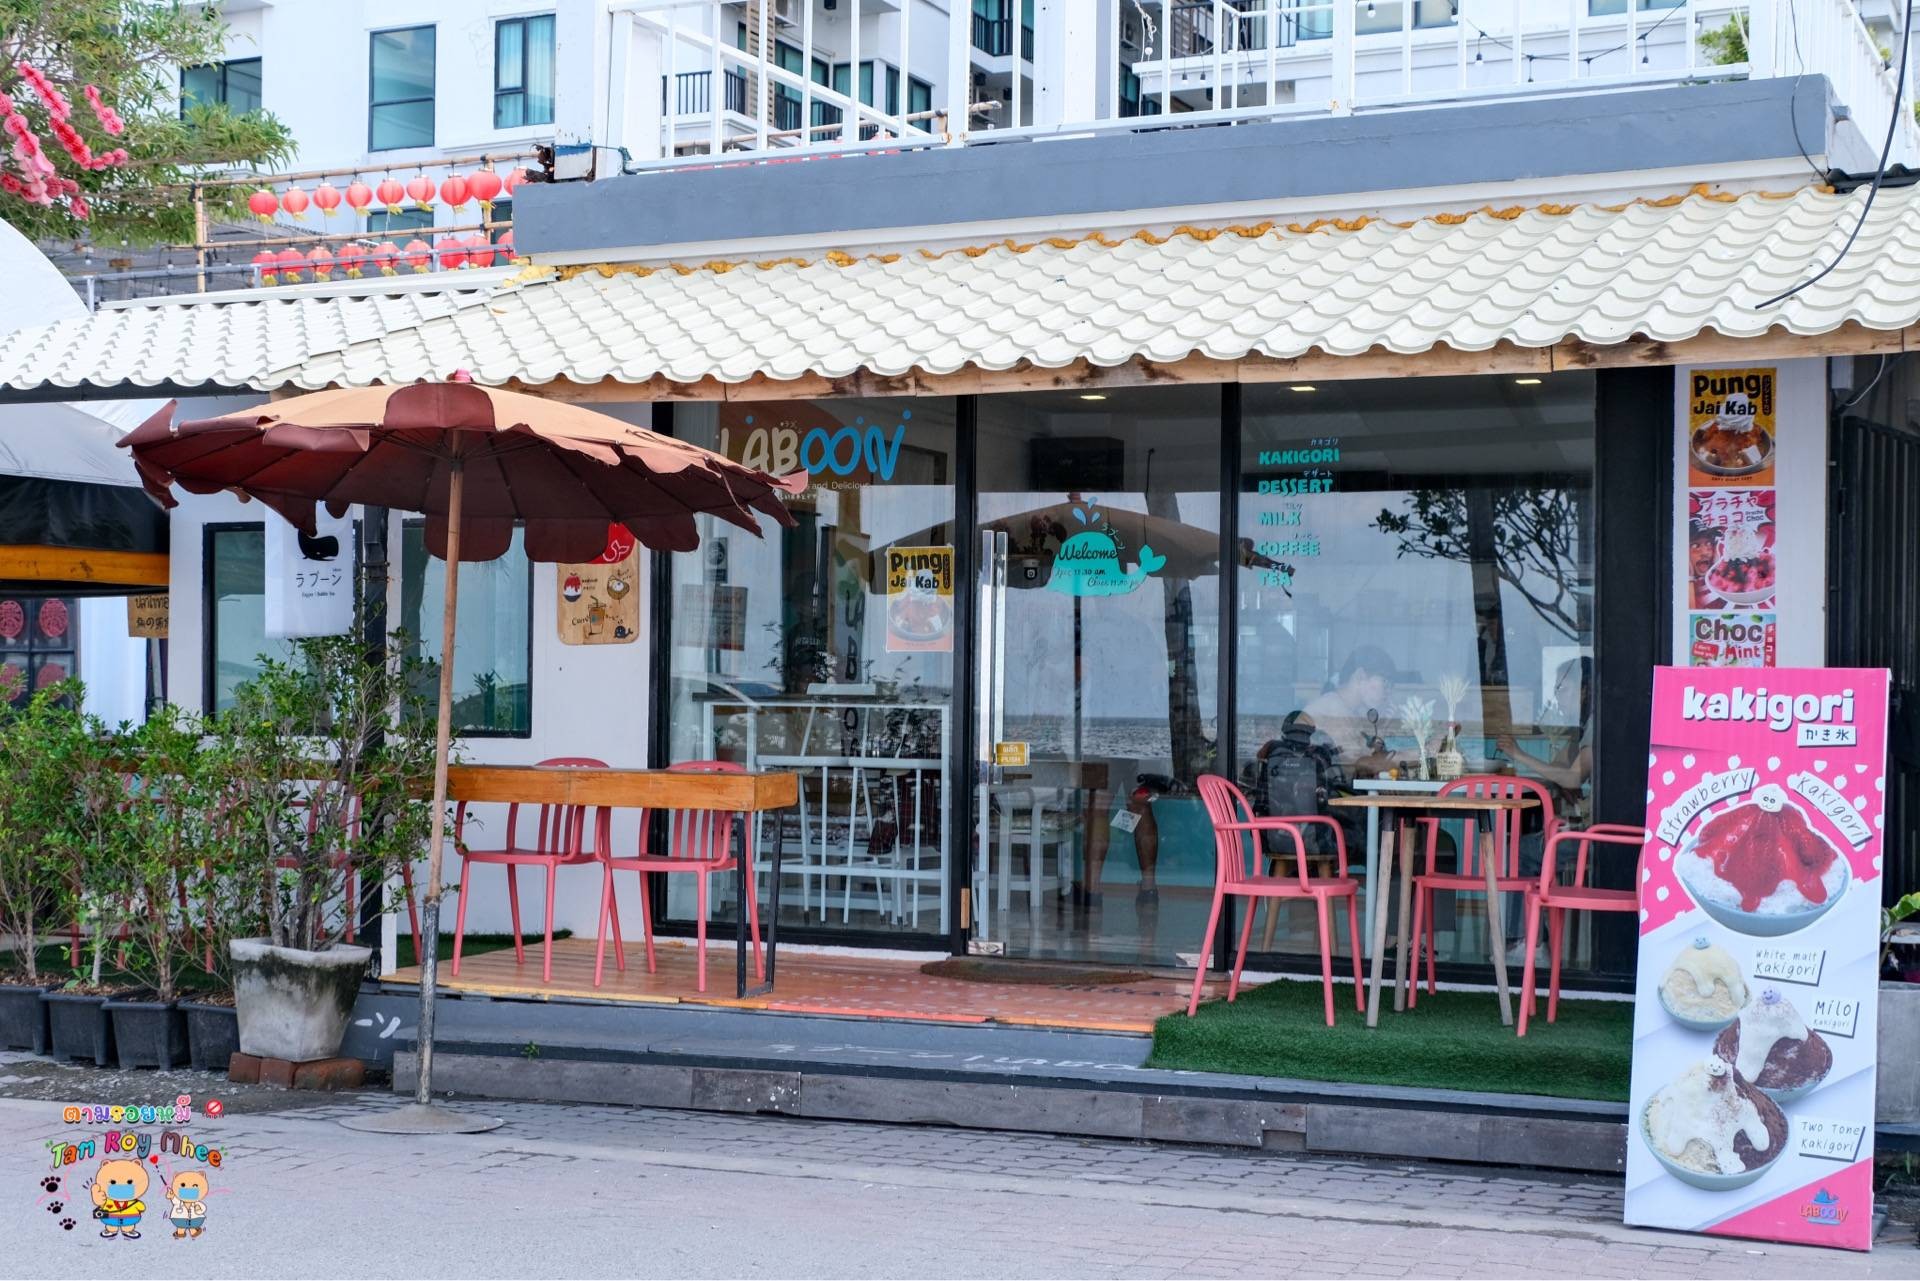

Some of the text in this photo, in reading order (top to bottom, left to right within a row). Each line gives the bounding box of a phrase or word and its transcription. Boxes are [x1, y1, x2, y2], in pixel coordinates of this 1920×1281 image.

[1694, 375, 1761, 398] Pung
[1693, 400, 1757, 415] Jai Kab
[1259, 448, 1340, 465] KAKIGORI
[812, 482, 828, 490] and
[1258, 478, 1333, 496] DESSERT
[1258, 512, 1302, 526] MILK
[1059, 542, 1118, 560] Welcome
[1257, 541, 1321, 556] COFFEE
[890, 553, 943, 574] Pung
[295, 570, 342, 588] ラブーン
[915, 576, 940, 589] Kab
[1258, 572, 1292, 587] TEA
[1695, 618, 1762, 642] Choc
[1725, 645, 1761, 659] Mint
[1682, 686, 1854, 731] kakigori
[1805, 729, 1850, 742] かき氷
[1755, 962, 1817, 979] Kakigori
[1815, 1000, 1852, 1017] Milo
[1801, 1138, 1854, 1154] Kakigori
